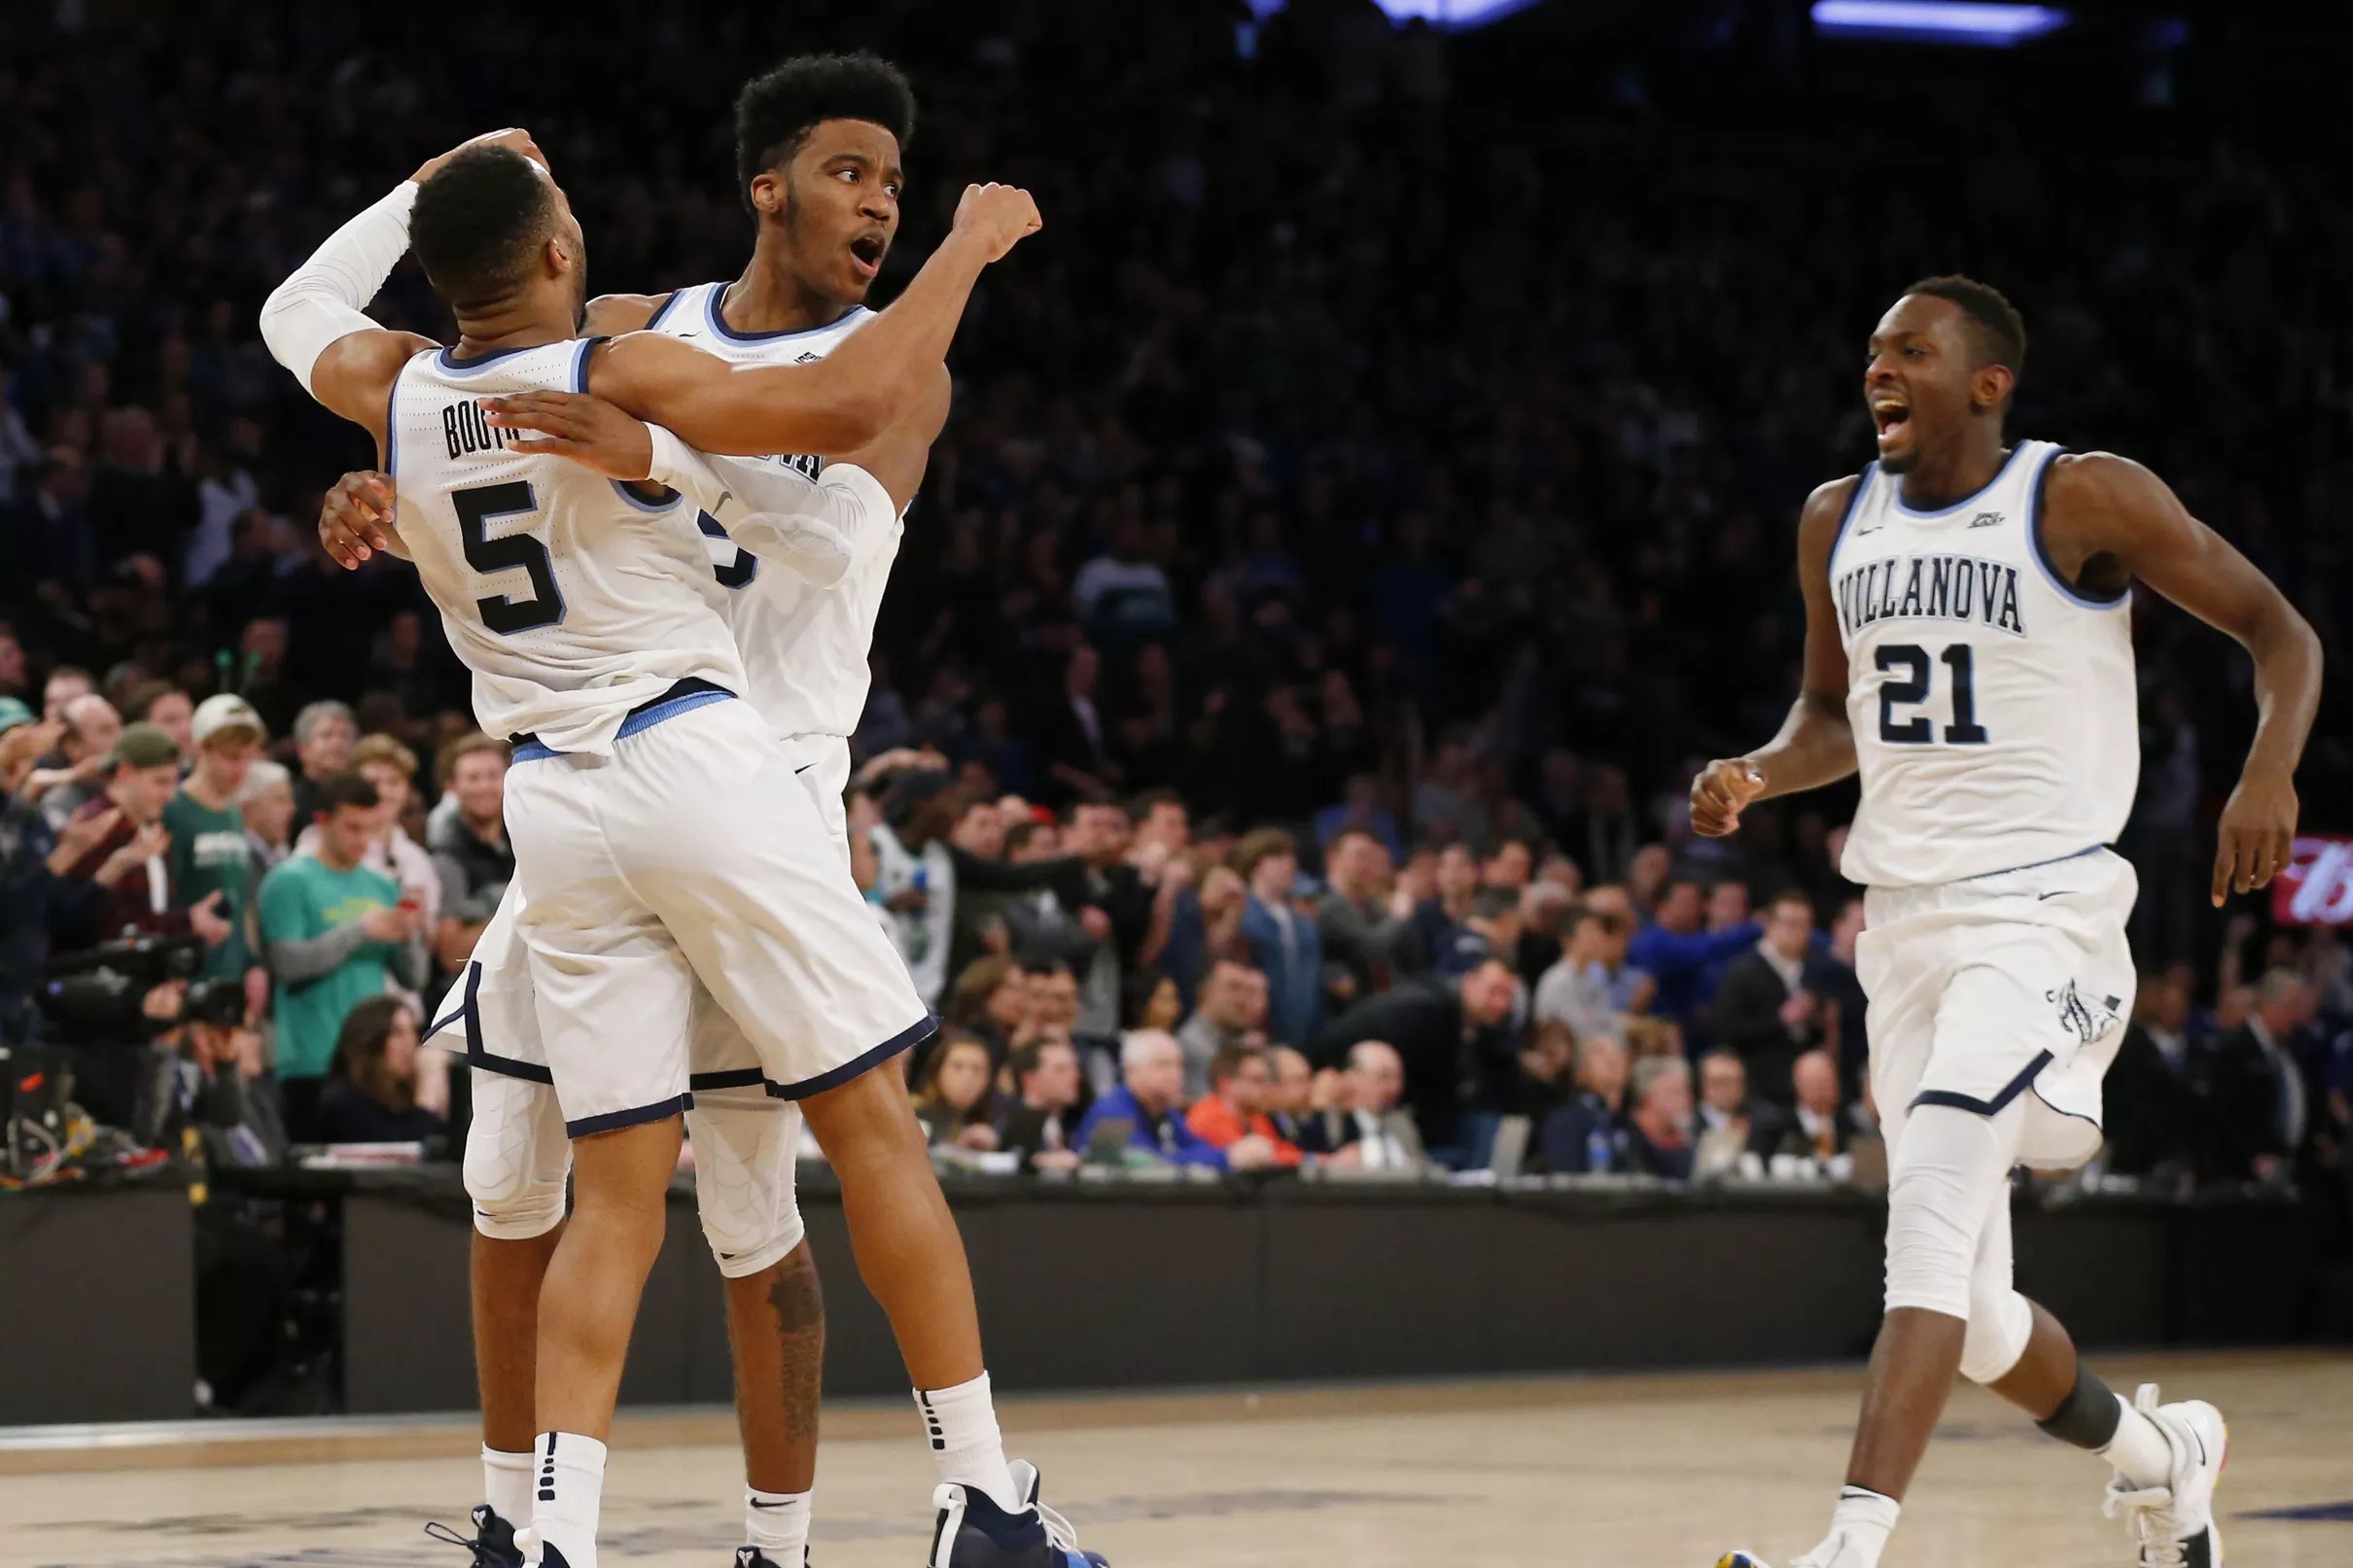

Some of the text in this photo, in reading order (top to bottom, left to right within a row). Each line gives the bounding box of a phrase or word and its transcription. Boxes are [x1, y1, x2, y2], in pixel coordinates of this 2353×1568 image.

[442, 399, 520, 460] BOO
[451, 479, 568, 637] 5
[1838, 554, 2024, 637] VILLANOVA
[1874, 643, 1990, 745] 21
